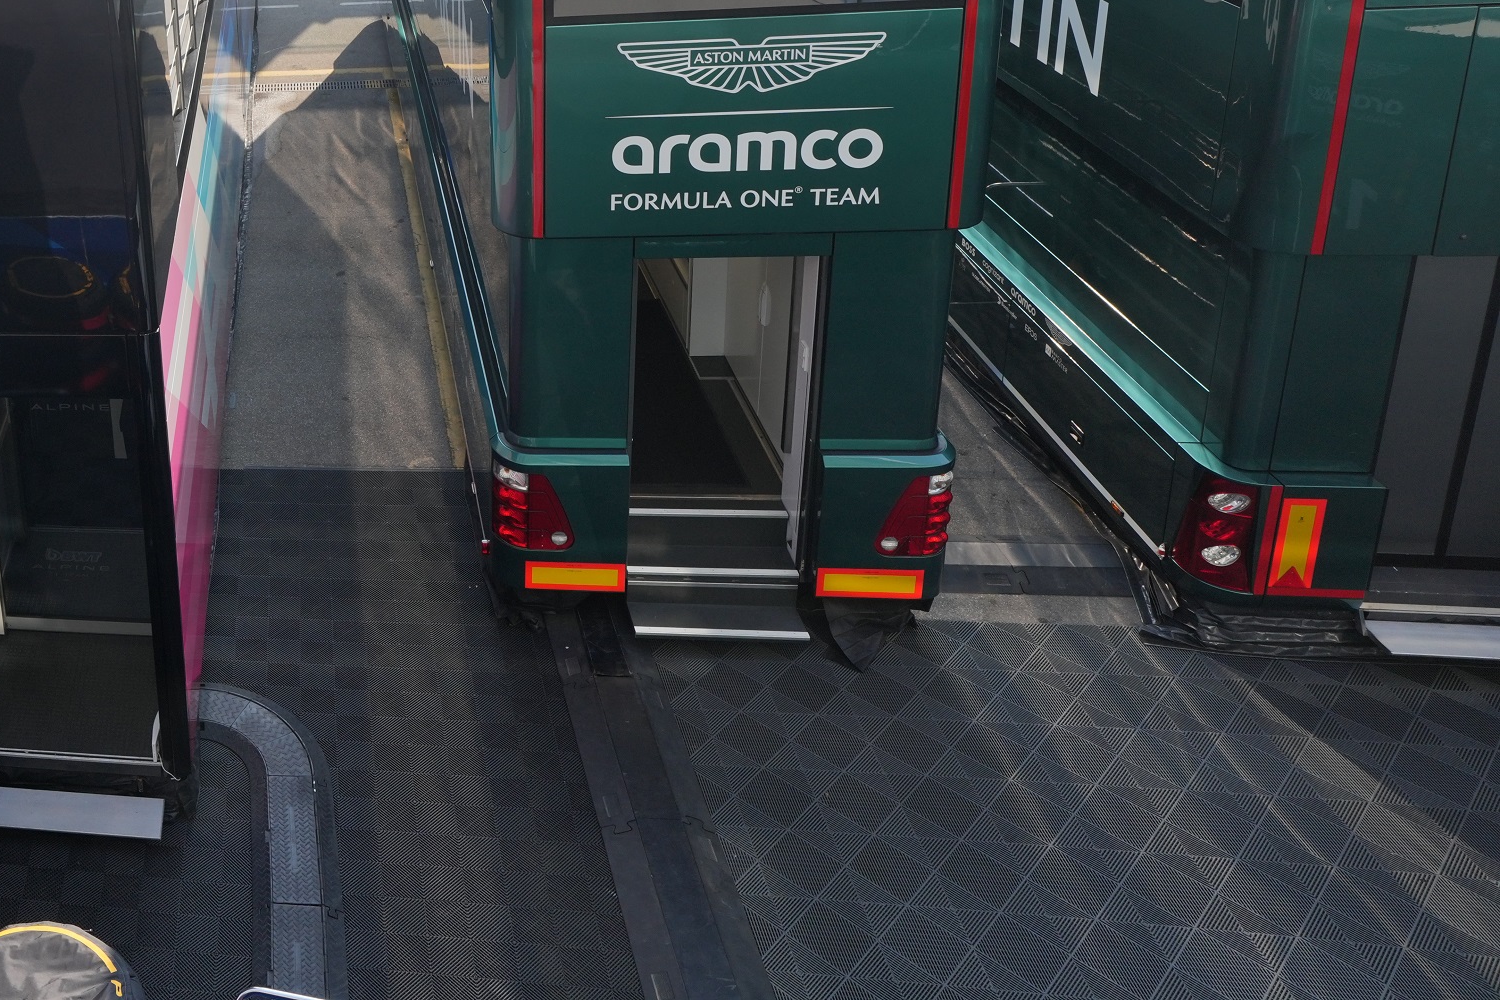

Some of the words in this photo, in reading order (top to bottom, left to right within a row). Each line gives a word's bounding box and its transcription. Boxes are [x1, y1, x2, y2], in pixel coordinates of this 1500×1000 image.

[693, 50, 744, 65] ASTON
[748, 48, 807, 63] MARTIN
[611, 128, 884, 175] aramco
[610, 190, 732, 211] FORMULA
[810, 187, 880, 206] TEAM
[961, 238, 976, 257] BOSS
[1010, 287, 1036, 317] aramco
